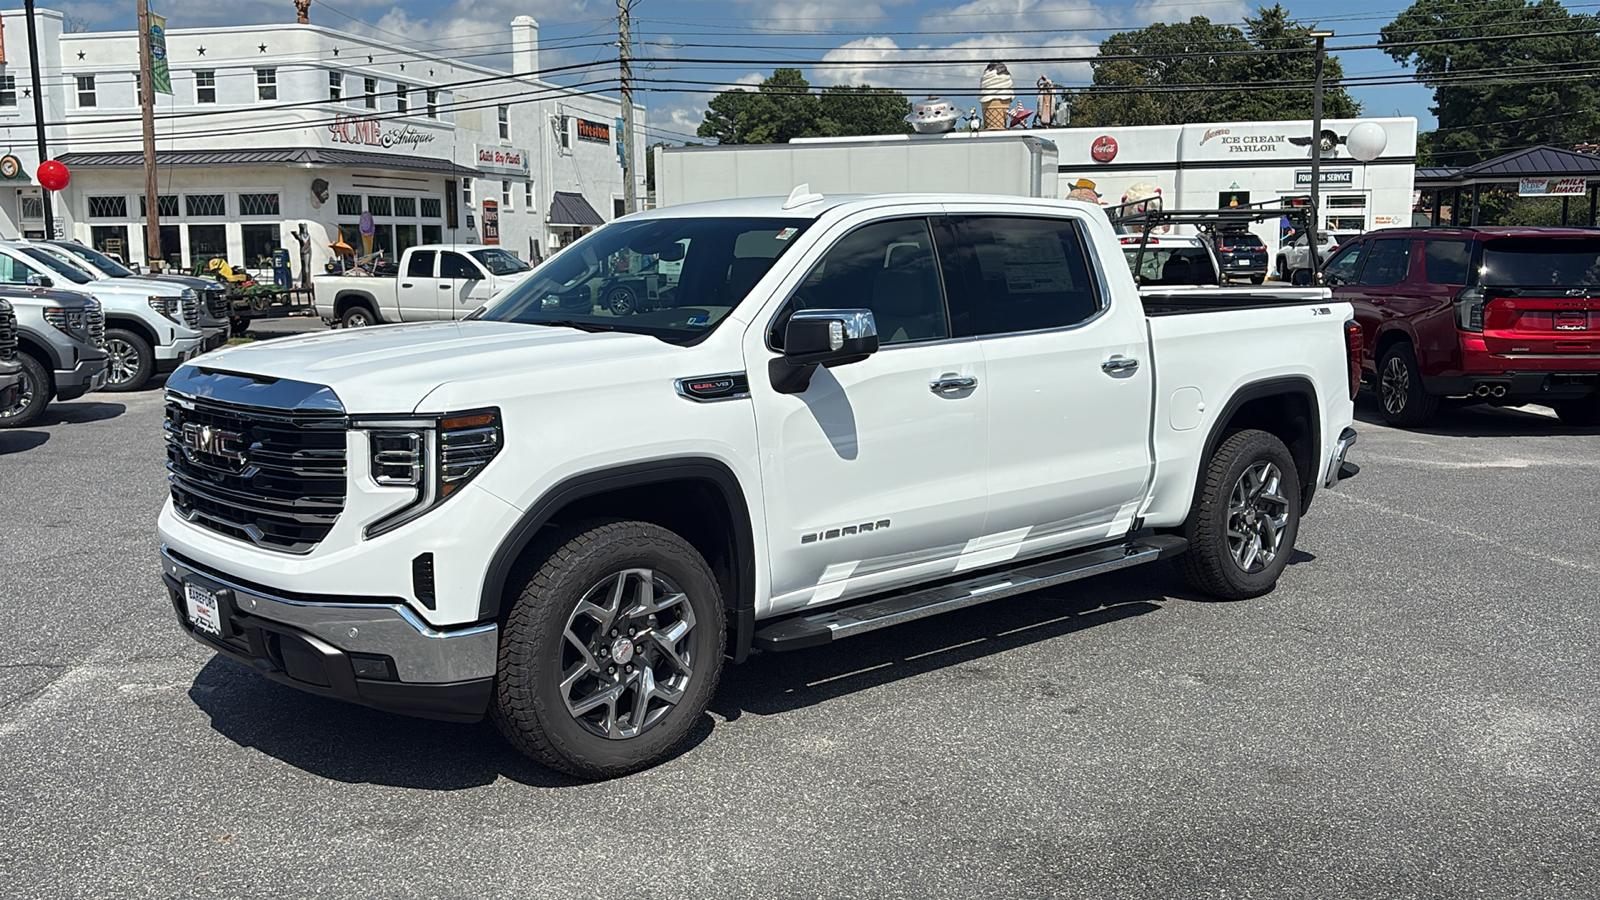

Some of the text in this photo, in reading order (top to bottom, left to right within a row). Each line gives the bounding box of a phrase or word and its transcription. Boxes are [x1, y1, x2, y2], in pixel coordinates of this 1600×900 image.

[328, 113, 381, 146] ACME
[394, 124, 435, 150] Antiques
[578, 120, 609, 139] Firestone
[1221, 135, 1285, 144] ICE CREAM
[1229, 144, 1276, 152] PARLOR
[479, 149, 494, 161] Dutch
[505, 152, 520, 164] Paints
[1298, 173, 1350, 182] FOUNIN SERVICE
[1552, 185, 1584, 193] SHAKES
[53, 228, 64, 237] 25
[487, 226, 497, 237] TEA
[182, 422, 246, 465] GMC
[801, 519, 890, 544] SIERRA
[189, 588, 216, 610] BAREFORD
[196, 604, 211, 618] GMC
